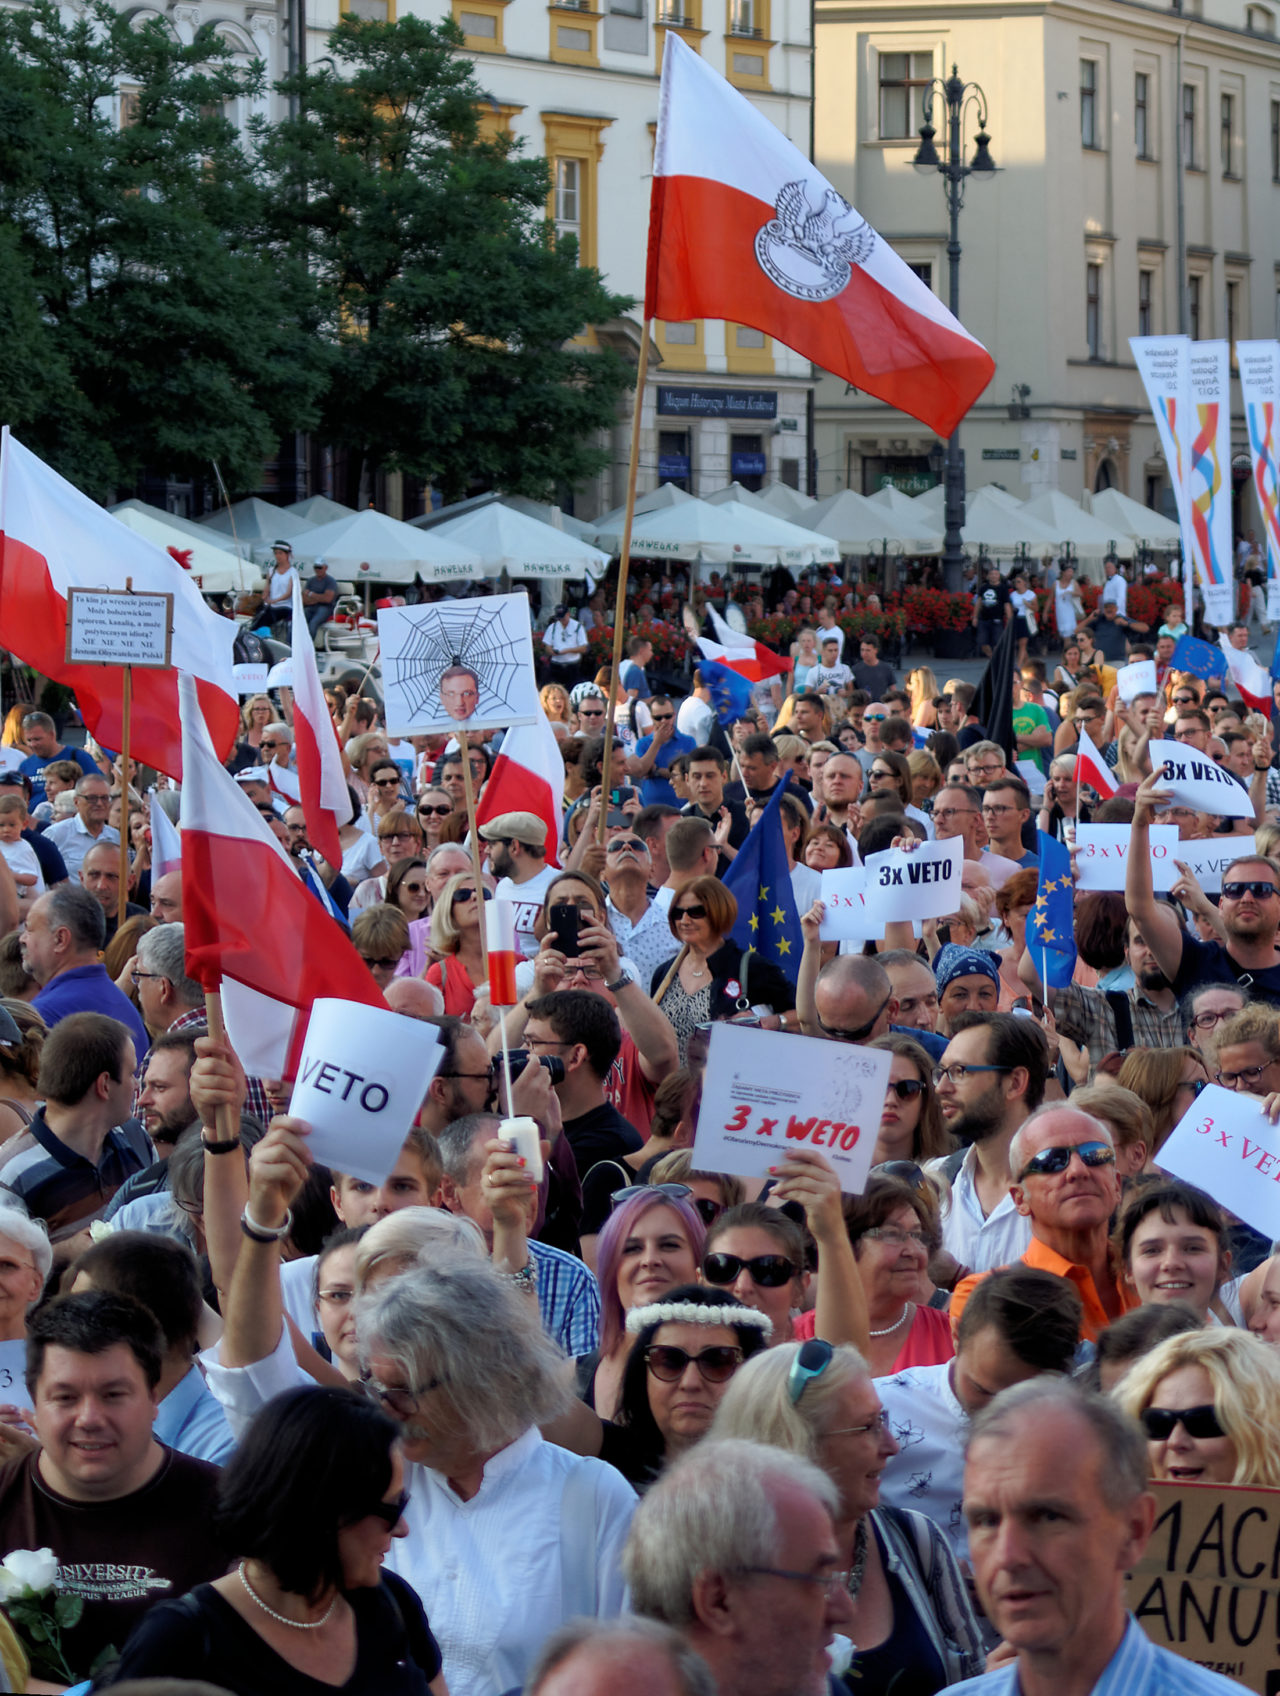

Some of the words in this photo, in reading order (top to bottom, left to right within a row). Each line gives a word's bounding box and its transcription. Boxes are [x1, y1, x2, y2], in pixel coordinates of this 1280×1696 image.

[1162, 758, 1187, 782] 3x
[1191, 760, 1234, 787] VETO
[1086, 843, 1096, 858] 3
[1100, 846, 1110, 858] x
[1115, 843, 1168, 859] VO
[879, 864, 903, 887] 3x
[907, 858, 953, 885] VETO
[829, 893, 840, 909] 3
[843, 896, 853, 908] x
[301, 1055, 390, 1114] VETO
[724, 1104, 752, 1132] 3
[755, 1117, 779, 1136] x
[785, 1114, 861, 1151] WETO
[1196, 1116, 1215, 1137] 3
[1214, 1129, 1234, 1149] x
[107, 1588, 148, 1600] LEAGUE
